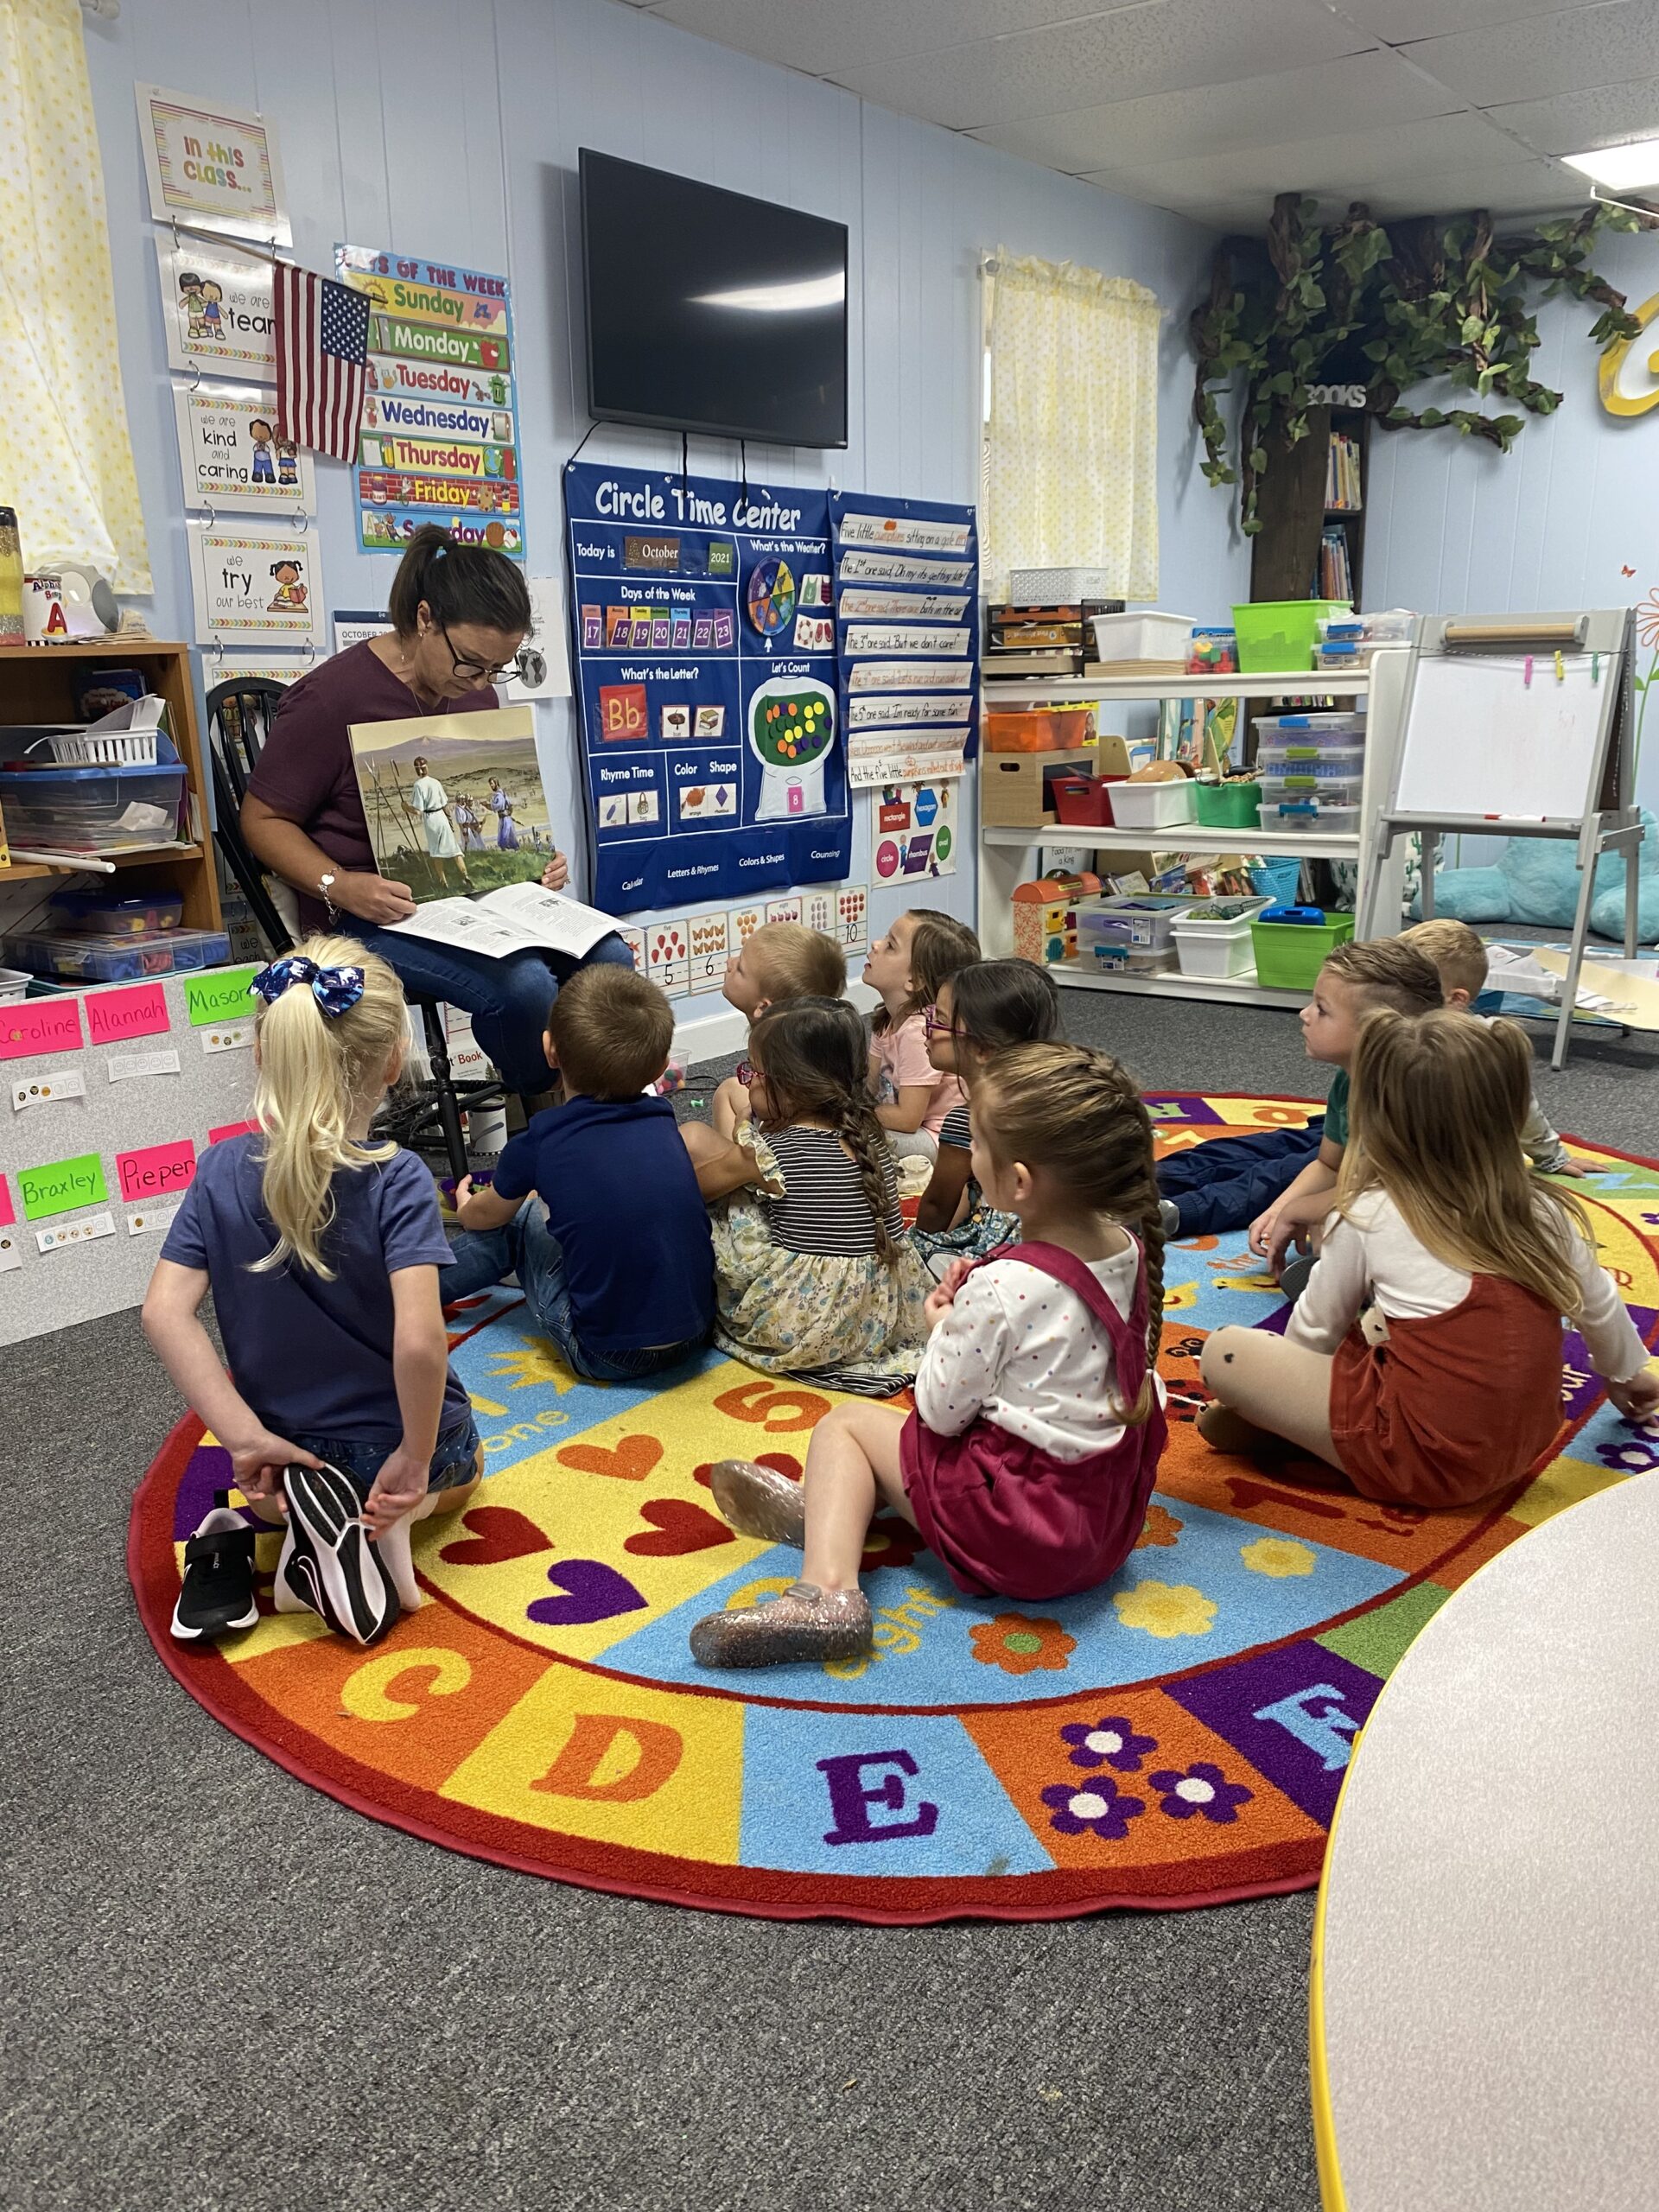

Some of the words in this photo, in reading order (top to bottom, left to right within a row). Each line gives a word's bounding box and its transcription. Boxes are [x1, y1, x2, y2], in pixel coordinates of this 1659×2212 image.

[397, 260, 419, 280] OF
[427, 265, 456, 288] THE
[463, 273, 505, 297] WEEK
[229, 292, 245, 304] we
[251, 296, 270, 308] are
[394, 283, 464, 322] Sunday
[395, 326, 469, 364] Monday
[396, 364, 470, 400] Tuesday
[200, 415, 215, 425] we
[219, 417, 236, 427] are
[381, 400, 489, 437] Wednesday
[202, 428, 237, 447] kind
[212, 449, 230, 461] and
[397, 442, 480, 474] Thursday
[198, 462, 248, 484] caring
[414, 480, 470, 508] Friday
[595, 481, 665, 519] Circle
[671, 488, 727, 525] Time
[732, 498, 801, 531] Center
[842, 521, 855, 538] Five
[856, 523, 874, 540] little
[576, 543, 605, 560] Today
[607, 544, 615, 558] is
[642, 544, 679, 559] October
[710, 552, 730, 563] 2021
[750, 539, 779, 552] What's
[780, 541, 794, 553] the
[226, 555, 243, 566] we
[842, 557, 853, 573] The
[865, 566, 877, 575] one
[222, 568, 252, 595] try
[216, 596, 233, 608] our
[238, 595, 264, 608] best
[620, 586, 642, 601] Days
[645, 586, 655, 600] of
[656, 588, 670, 601] the
[671, 588, 696, 601] Week
[47, 602, 67, 633] A
[587, 626, 599, 639] 17
[615, 626, 628, 638] 18
[635, 628, 648, 639] 19
[655, 626, 668, 639] 20
[677, 627, 687, 639] 21
[696, 627, 709, 639] 22
[717, 626, 729, 639] 23
[848, 632, 858, 649] The
[910, 640, 918, 649] we
[620, 667, 654, 680] What's
[655, 667, 670, 680] the
[671, 667, 699, 680] Letter?
[772, 662, 787, 674] Let's
[787, 662, 810, 673] Count
[608, 697, 640, 731] Bb
[867, 710, 877, 720] one
[601, 768, 630, 783] Rhyme
[631, 766, 654, 779] Time
[674, 762, 698, 775] Color
[709, 760, 737, 774] Shape
[851, 766, 862, 782] And
[792, 794, 798, 805] 8
[739, 856, 760, 868] Colors
[760, 855, 766, 865] &
[810, 849, 841, 859] Counting
[880, 854, 893, 863] circle
[667, 867, 690, 879] Letters
[690, 866, 696, 875] &
[696, 864, 719, 875] Rhymes
[846, 924, 858, 943] 10
[240, 938, 258, 950] we
[664, 963, 673, 985] 5
[705, 956, 714, 976] 6
[92, 1001, 164, 1033] Alannah
[457, 1051, 483, 1065] Book
[123, 1159, 196, 1193] Pieper
[22, 1173, 96, 1205] Braxley
[481, 1410, 570, 1452] one
[341, 1647, 473, 1722] C
[1252, 1682, 1364, 1771] F
[531, 1713, 684, 1802] D
[817, 1748, 939, 1847] E
